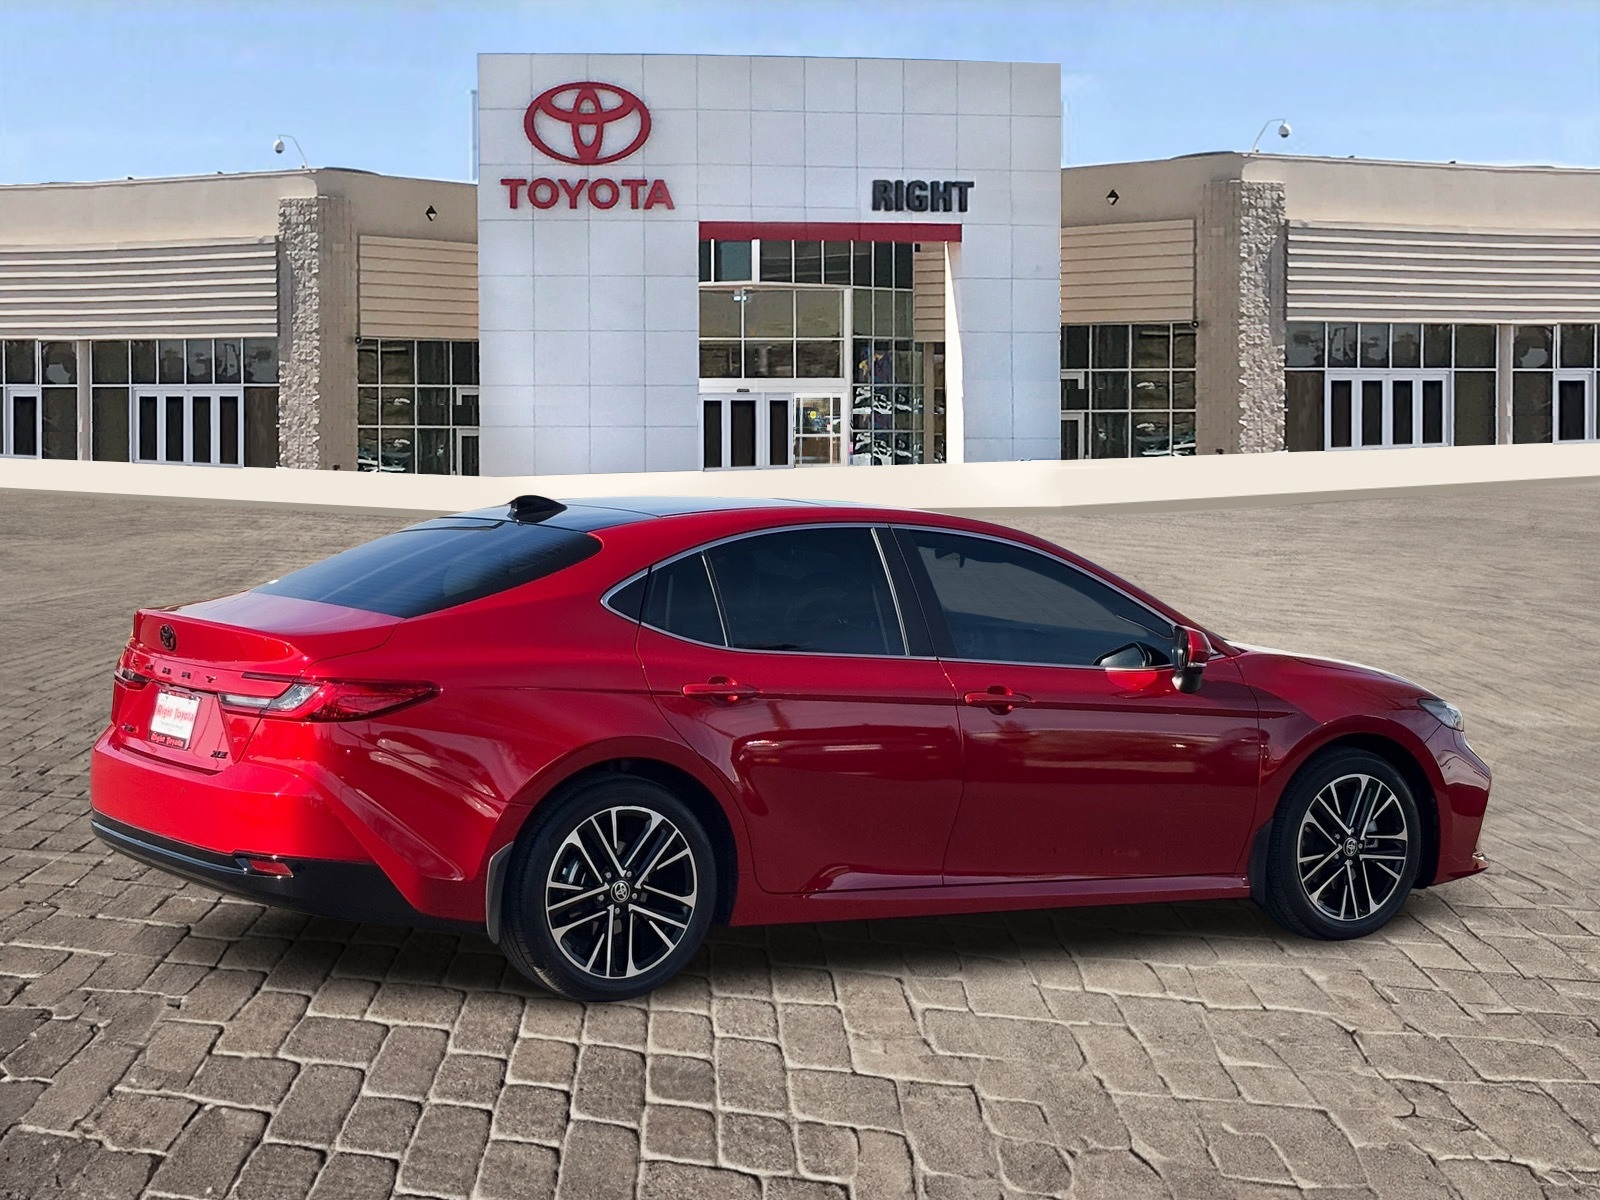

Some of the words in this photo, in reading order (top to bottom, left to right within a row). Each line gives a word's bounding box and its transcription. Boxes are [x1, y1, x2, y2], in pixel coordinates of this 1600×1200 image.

[500, 177, 675, 210] TOYOTA
[872, 179, 974, 212] RIGHT
[156, 704, 173, 719] Right
[174, 708, 194, 722] Toyota
